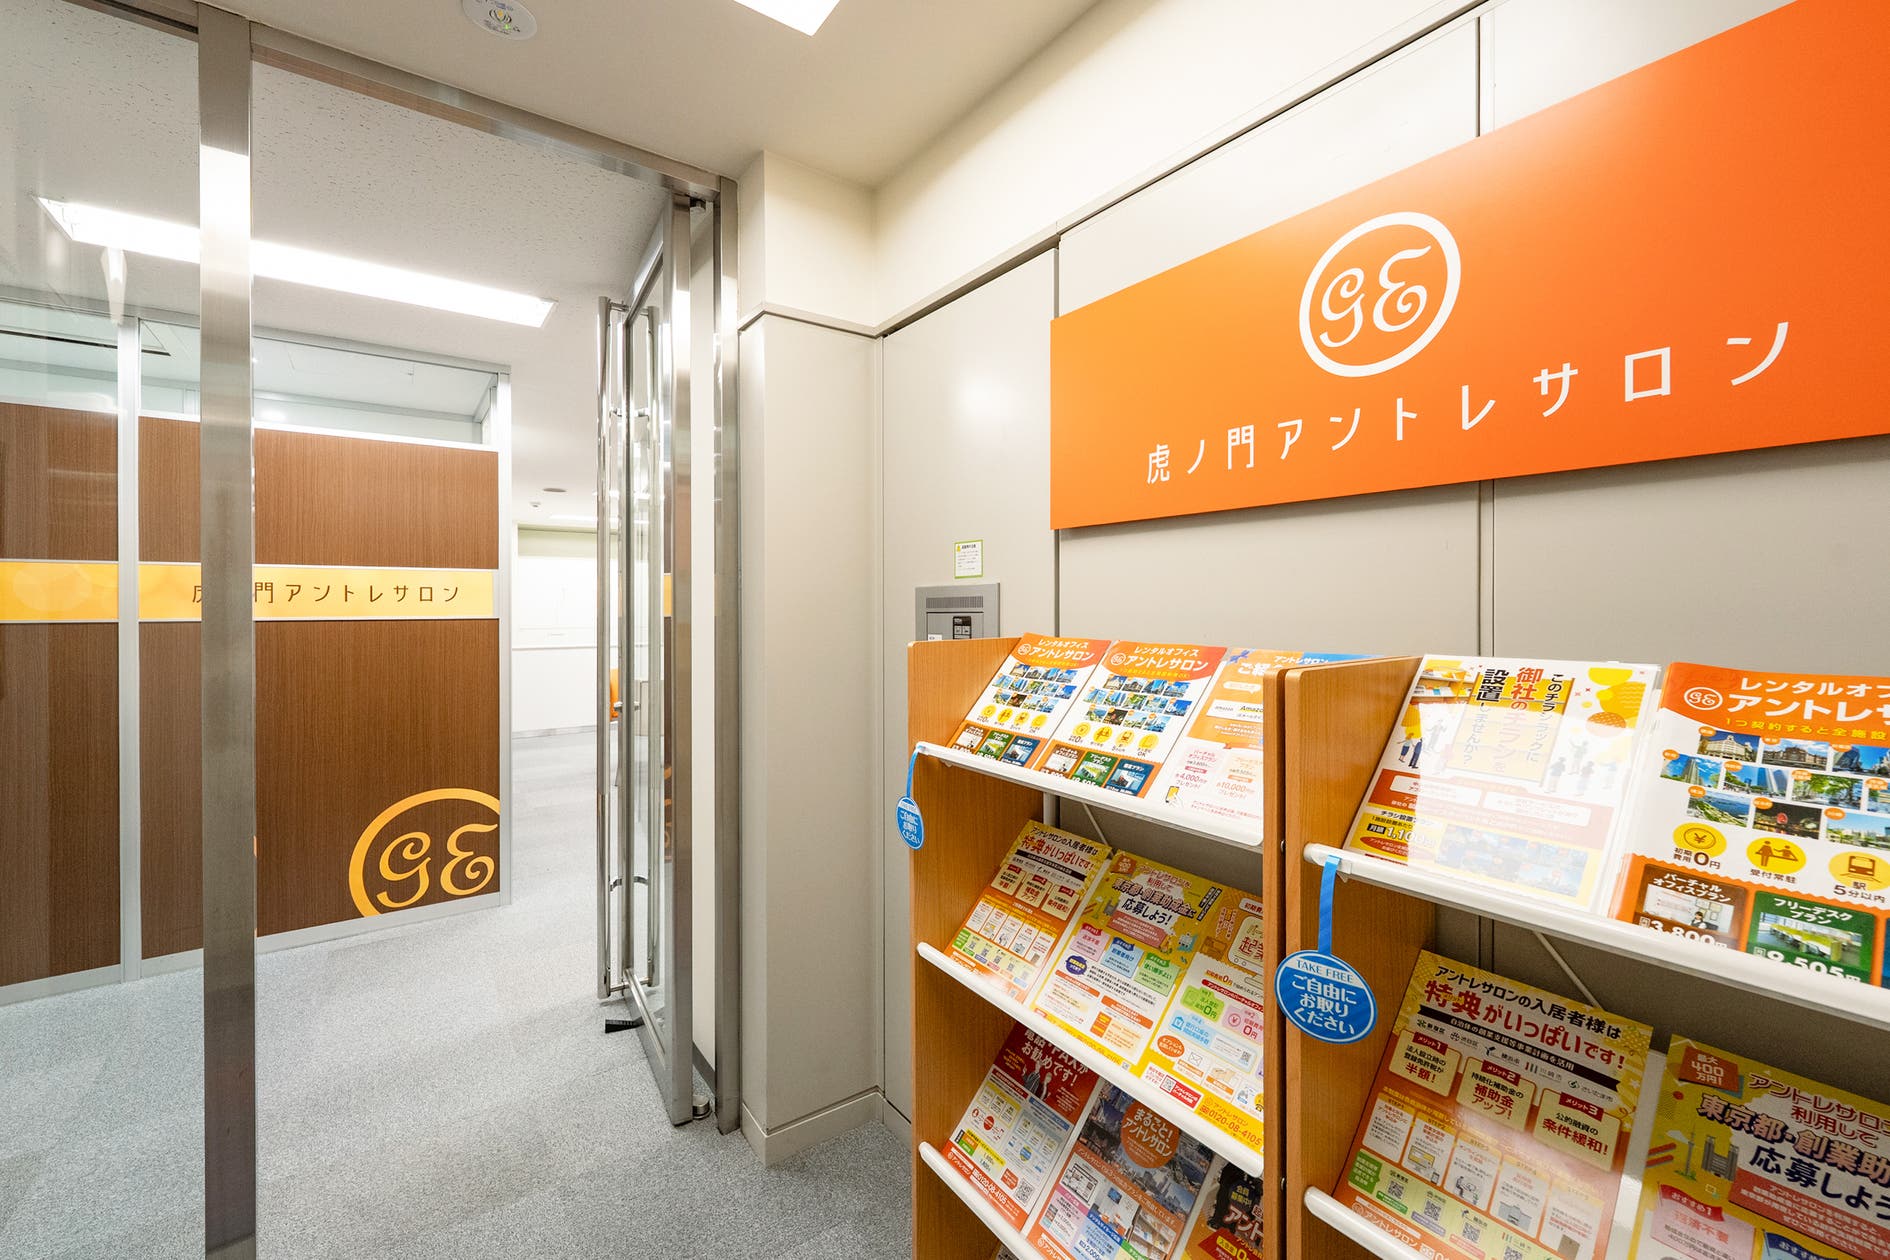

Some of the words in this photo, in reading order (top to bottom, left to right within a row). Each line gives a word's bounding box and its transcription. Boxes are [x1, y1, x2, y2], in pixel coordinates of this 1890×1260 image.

[1146, 321, 1789, 485] 虎ノ門アントレサロン
[192, 582, 460, 604] 門アントレサロン
[1029, 646, 1095, 661] アントレサロン
[1038, 639, 1089, 649] レンタルオフィス
[1135, 646, 1200, 657] レンタルオフィス
[1125, 655, 1209, 671] アントレサロン
[1274, 655, 1329, 665] アントレサロン
[1725, 718, 1888, 741] 1つ契約すると全施設
[1693, 852, 1721, 870] 0円
[1664, 873, 1722, 892] バーチャル
[1750, 869, 1797, 884] 受付常駐
[1853, 881, 1867, 890] 駅
[1653, 878, 1732, 902] オフィスプラン
[1834, 884, 1887, 904] 5分以内
[1122, 898, 1172, 925] 応募しよう!
[1774, 898, 1853, 921] フリーデスク
[1790, 910, 1832, 925] プラン
[1296, 960, 1322, 975] TAKE
[1326, 969, 1354, 984] FREE
[1292, 974, 1357, 1005] ご自由に
[1300, 993, 1348, 1018] お取り
[1435, 965, 1623, 1040] アントレサロンの入居者様は
[1242, 1024, 1258, 1039] 0円
[1294, 1007, 1355, 1035] ください
[1424, 980, 1626, 1071] 特典がいっぱいです!
[1021, 1040, 1078, 1087] お勧めです!
[1405, 1062, 1437, 1084] 半額!
[1487, 1065, 1517, 1081] メリット2
[1691, 1060, 1725, 1077] 400
[1471, 1072, 1524, 1099] 持続化補助金の
[1474, 1083, 1514, 1109] 補助金
[1214, 1101, 1249, 1127] アントレサロン
[1472, 1093, 1513, 1119] アップ!
[1565, 1097, 1598, 1115] メリット3
[1134, 1108, 1174, 1143] まるごと!
[1208, 1109, 1262, 1146] 0120-08-4105
[1555, 1112, 1599, 1136] 公的融資の
[1791, 1106, 1879, 1149] 利用して
[1121, 1116, 1173, 1157] アントレサロン
[1542, 1118, 1609, 1156] 条件緩和!
[1672, 1192, 1712, 1215] おすすめ1
[1365, 1212, 1418, 1247] アントレサロン
